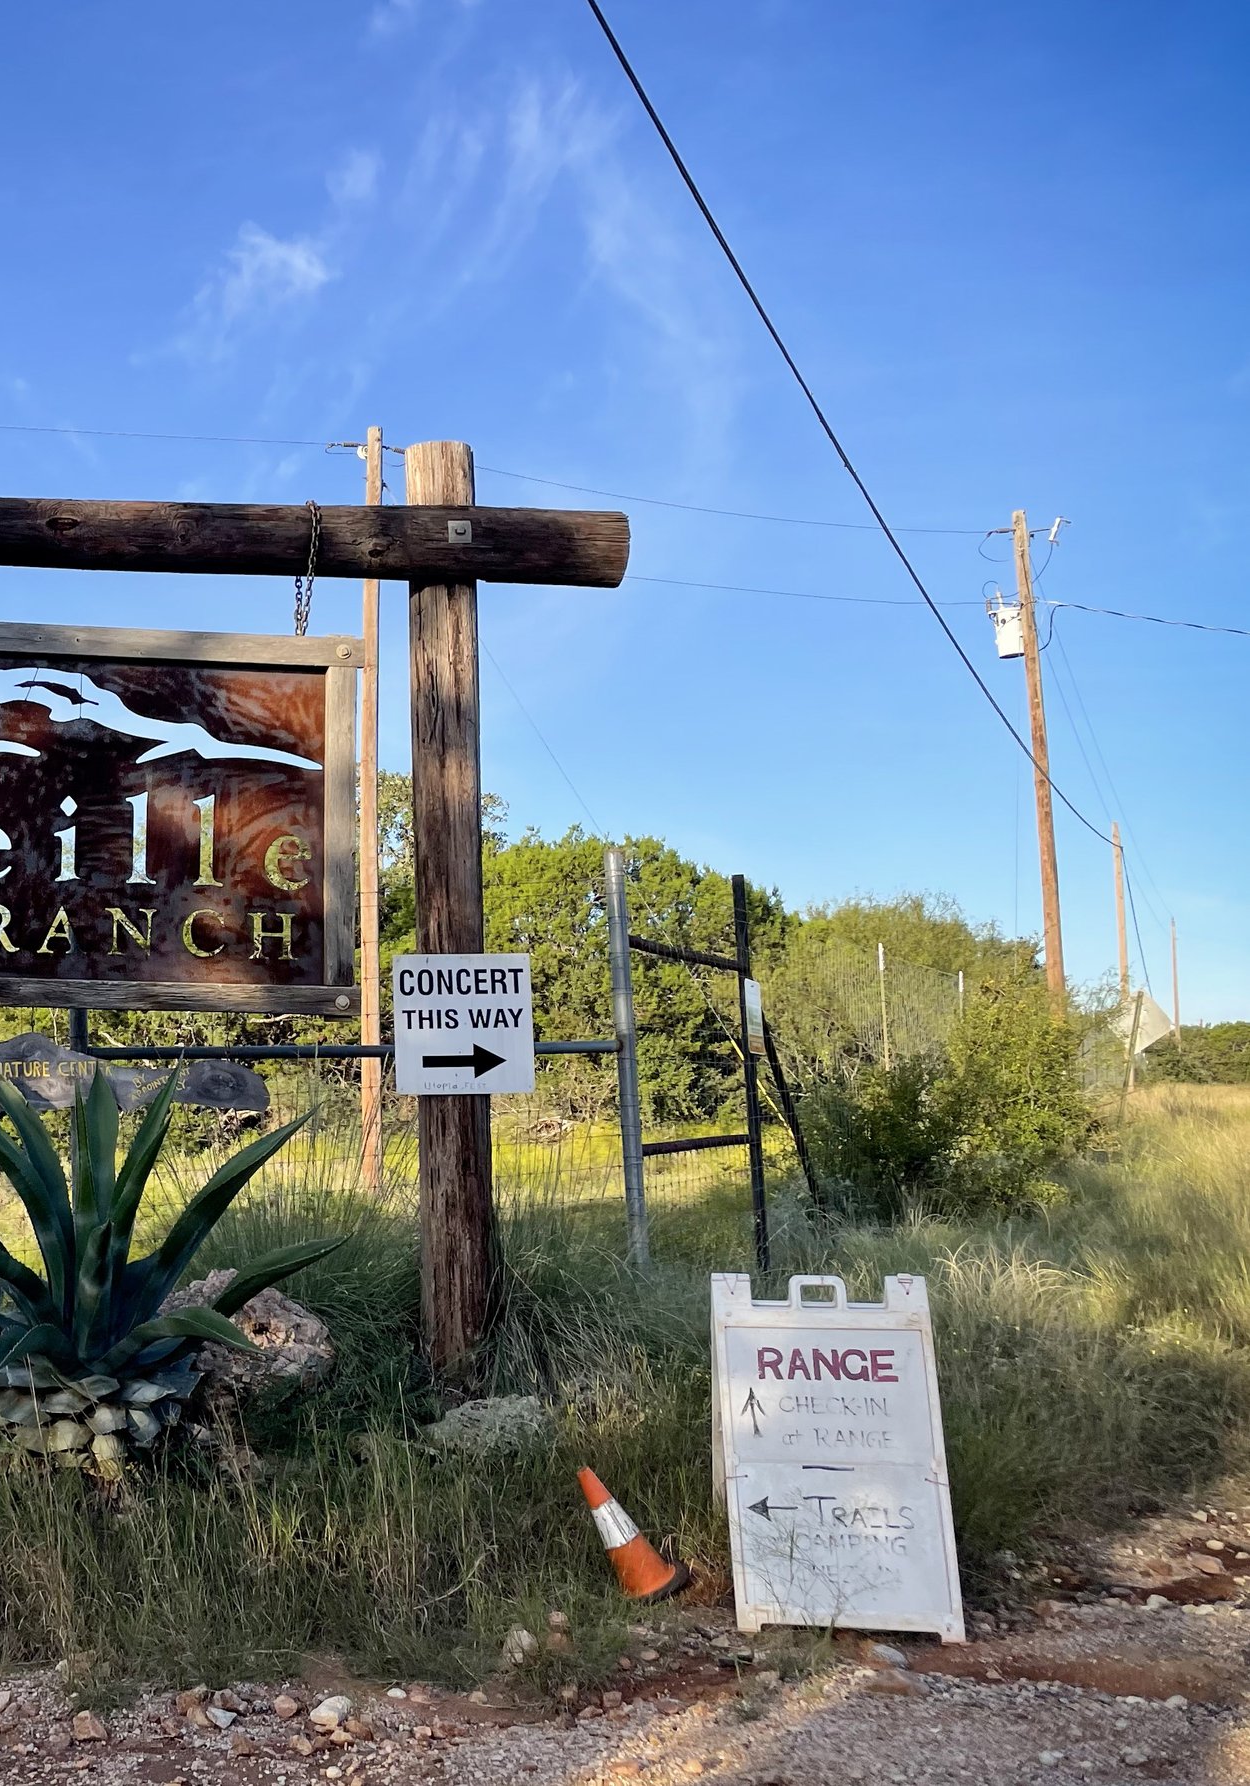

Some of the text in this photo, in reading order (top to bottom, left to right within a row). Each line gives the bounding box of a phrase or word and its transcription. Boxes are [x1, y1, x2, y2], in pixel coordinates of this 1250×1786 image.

[399, 968, 524, 996] CONCERT
[402, 1008, 524, 1030] THIS WAY
[132, 1073, 146, 1088] BY
[757, 1347, 899, 1383] RANGE
[814, 1427, 896, 1449] RANGE
